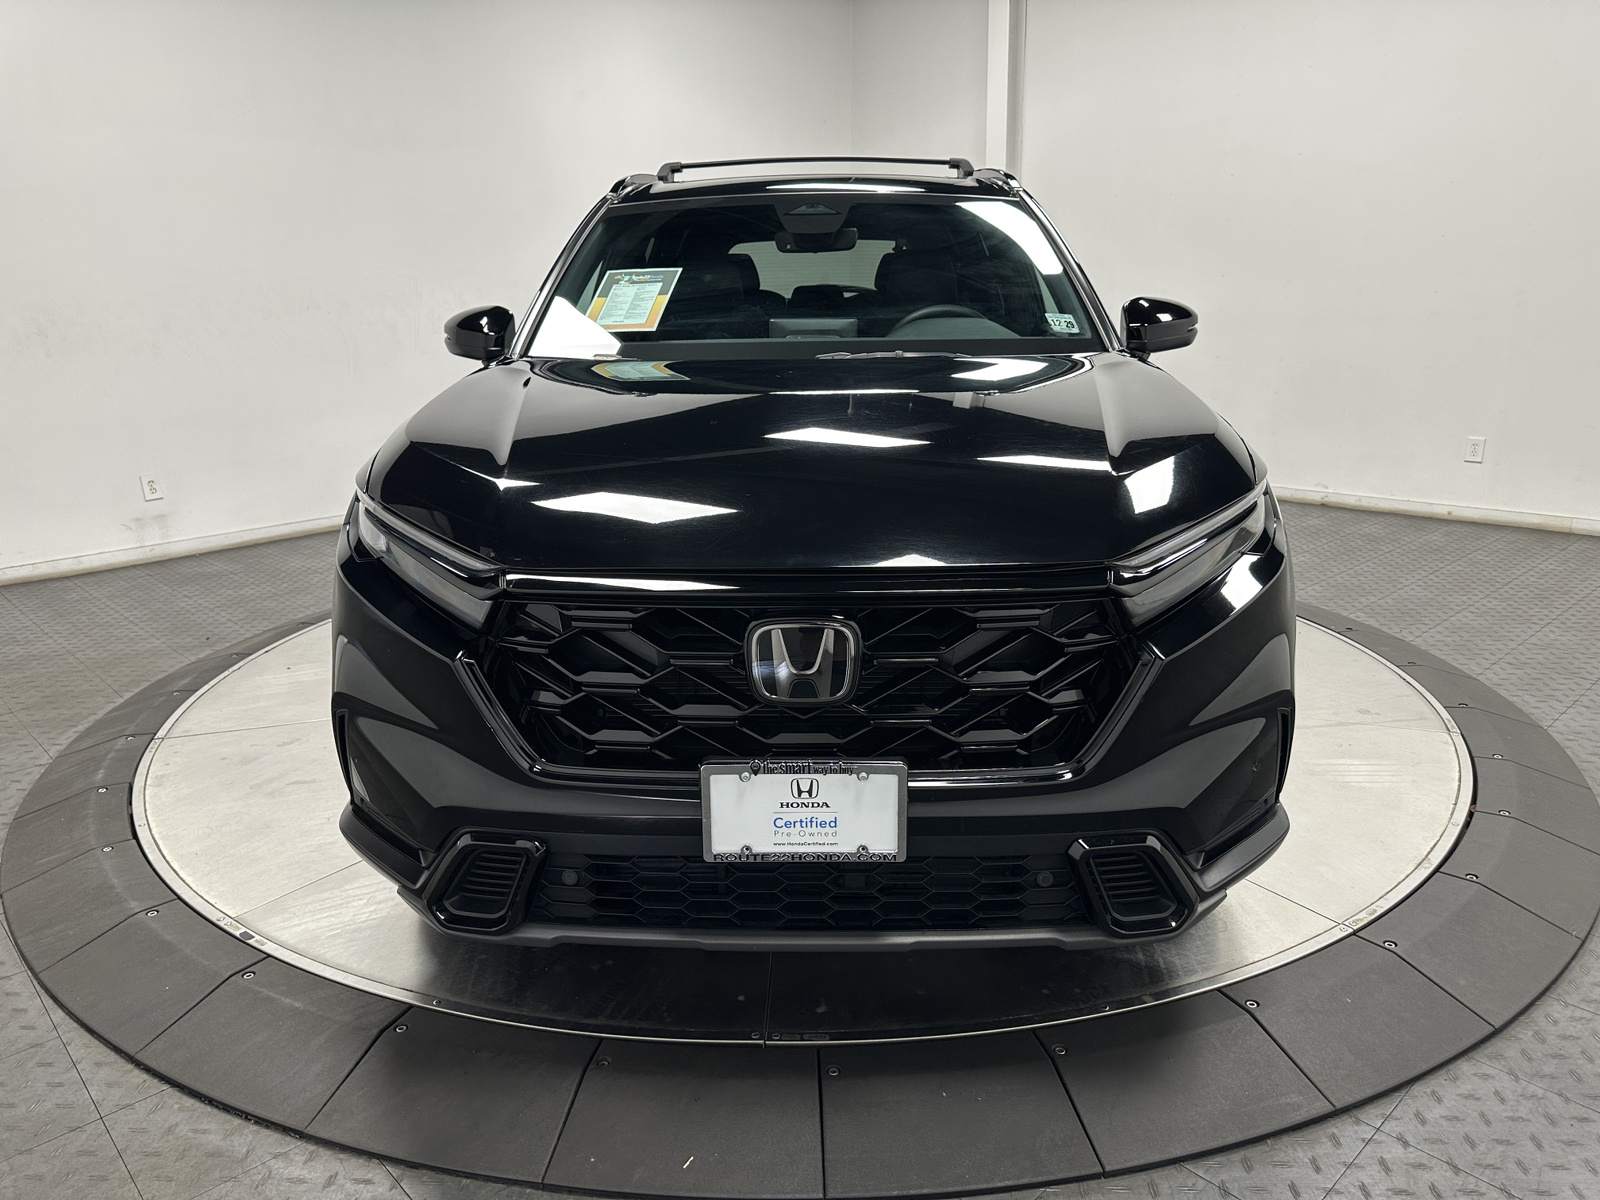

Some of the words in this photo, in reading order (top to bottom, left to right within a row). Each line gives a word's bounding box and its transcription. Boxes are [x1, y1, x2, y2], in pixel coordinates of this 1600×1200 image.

[762, 759, 777, 775] the
[779, 759, 811, 775] smart
[812, 764, 828, 776] way
[829, 762, 838, 775] to
[840, 760, 854, 776] buy
[779, 801, 831, 809] HONDA
[773, 816, 838, 829] Certified
[773, 829, 838, 838] Pre-Owned
[713, 853, 898, 862] ROUTE22HONDA.COM
